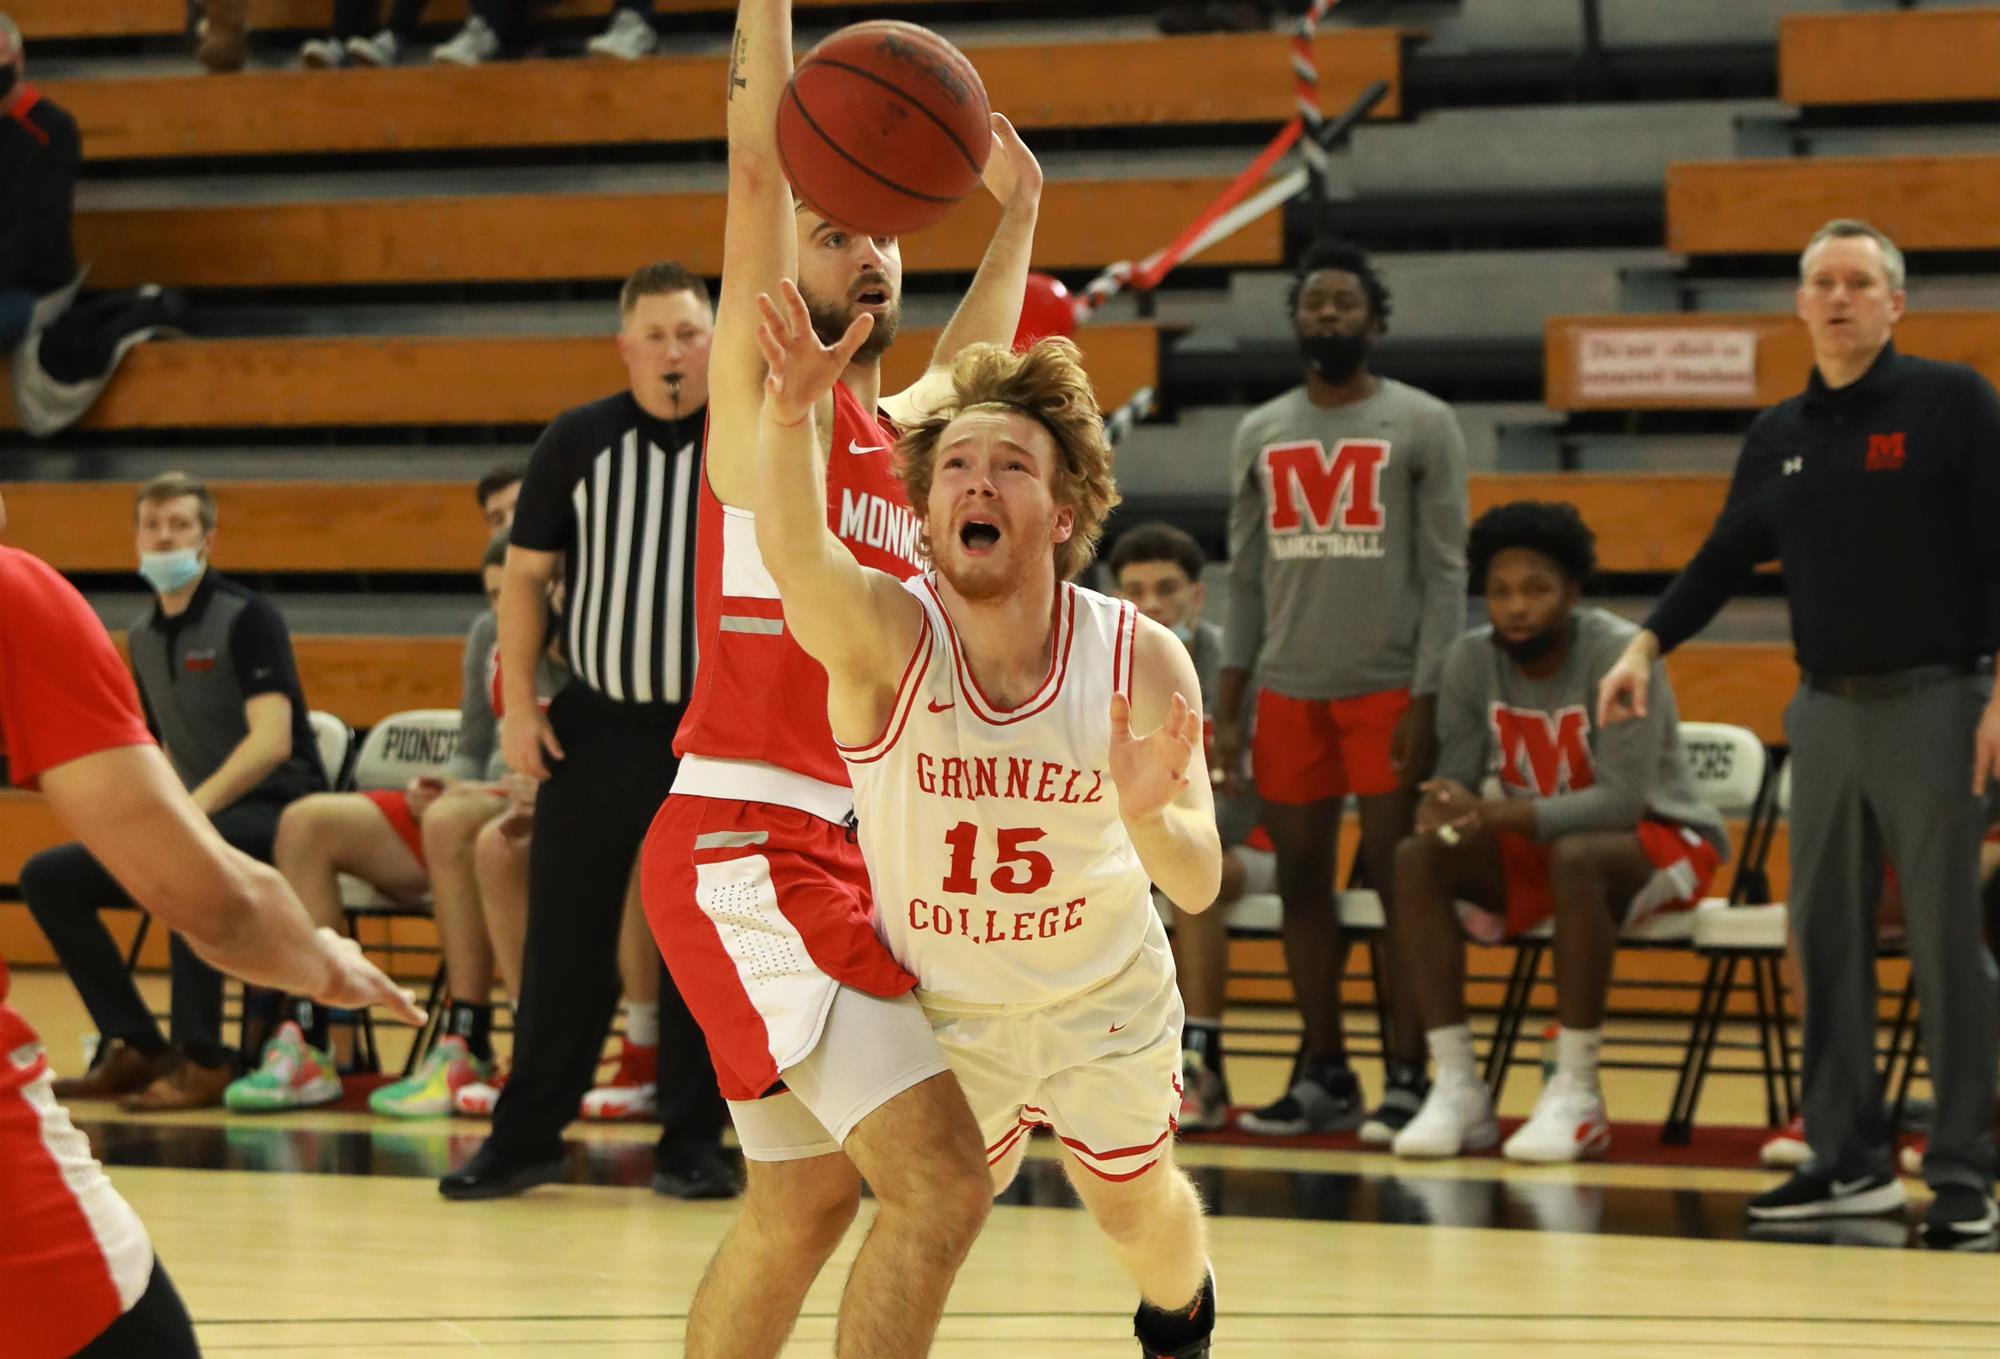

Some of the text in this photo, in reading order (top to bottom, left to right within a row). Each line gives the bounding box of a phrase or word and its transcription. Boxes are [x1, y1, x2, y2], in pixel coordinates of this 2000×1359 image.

[1260, 438, 1392, 534] M
[839, 487, 931, 574] MONMO
[916, 752, 1103, 803] GRINNELL
[1488, 700, 1596, 798] M
[942, 821, 1055, 895] 15
[908, 897, 1087, 944] COLLEGE
